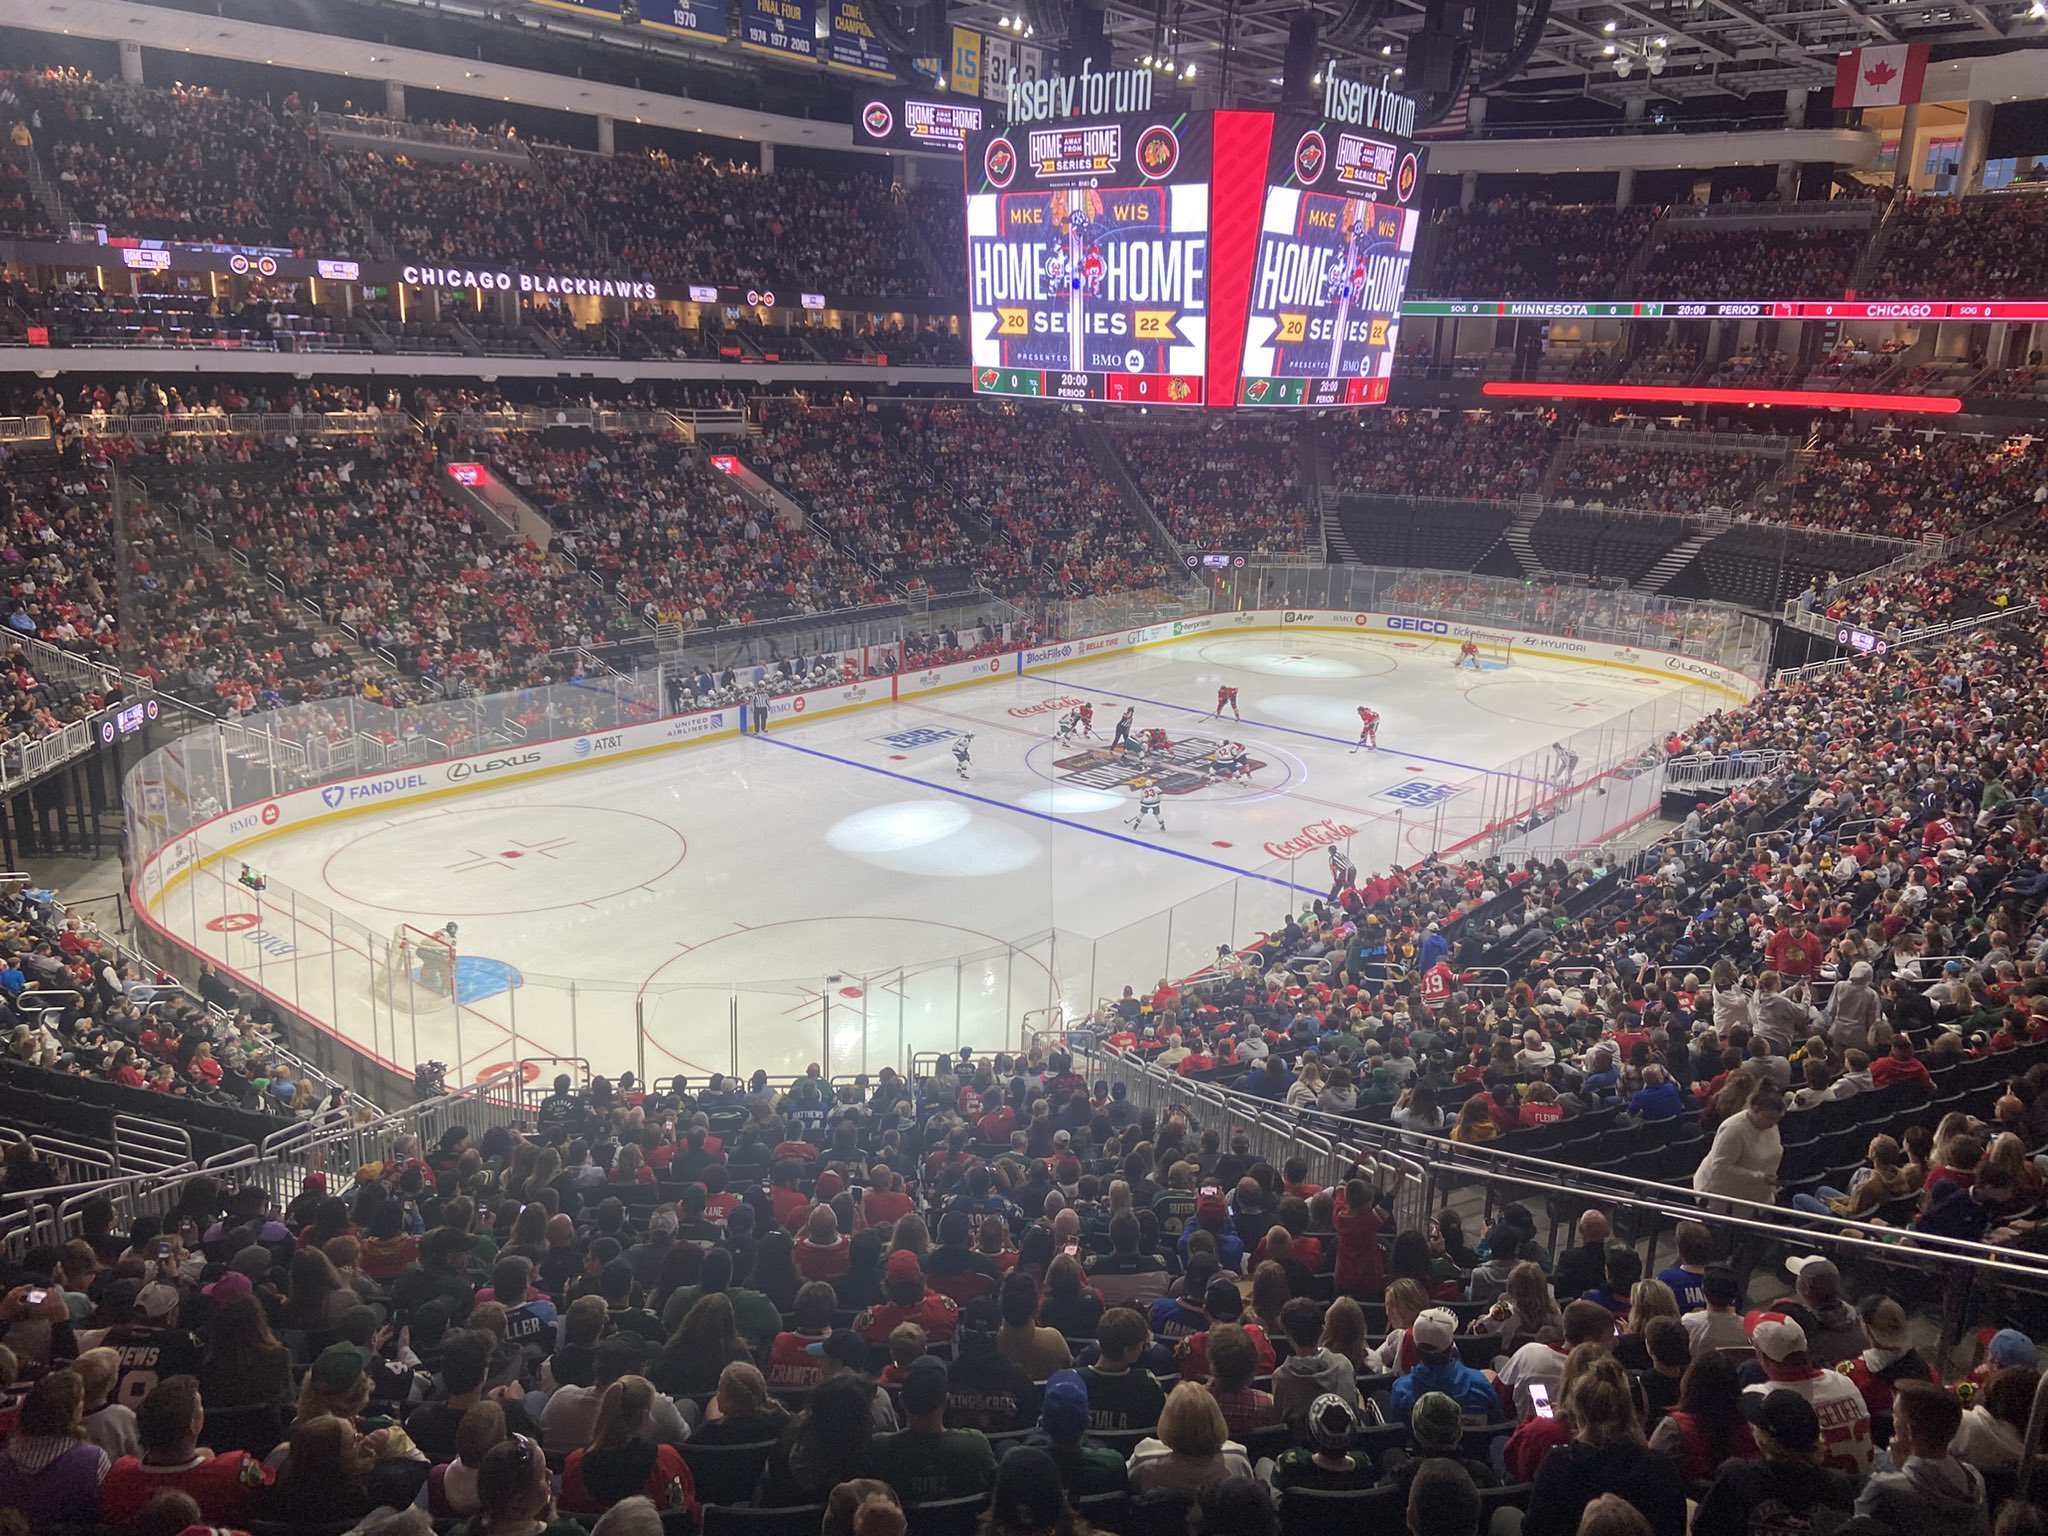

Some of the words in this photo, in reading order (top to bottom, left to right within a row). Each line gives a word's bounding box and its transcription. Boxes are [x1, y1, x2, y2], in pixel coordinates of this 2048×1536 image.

[781, 0, 801, 20] FOUR
[673, 9, 697, 28] 1970
[749, 28, 767, 43] 1974
[770, 32, 788, 47] 1977
[791, 37, 810, 53] 2003
[956, 47, 977, 79] 15
[991, 56, 1007, 85] 31
[908, 105, 935, 125] HOME
[952, 110, 979, 130] HOME
[929, 127, 960, 137] SERIES
[1032, 132, 1063, 162] HOME
[1084, 127, 1117, 157] HOME
[1064, 137, 1082, 146] AWAY
[1064, 145, 1082, 153] FROM
[1339, 138, 1364, 168] HOME
[1373, 146, 1395, 176] HOME
[1056, 161, 1091, 171] SERIES
[1354, 169, 1377, 182] SERIES
[1010, 208, 1043, 224] MKE
[1113, 204, 1149, 222] WIS
[1309, 209, 1336, 228] MKE
[1378, 220, 1395, 238] WIS
[974, 242, 1048, 306] HOME
[1107, 239, 1205, 309] HOME
[1258, 240, 1334, 310] HOME
[1361, 254, 1410, 319] HOME
[403, 266, 511, 290] CHICAGO
[519, 274, 656, 299] BLACKHAWKS
[1451, 305, 1466, 313] SOG
[1472, 304, 1479, 313] 0
[1511, 304, 1588, 315] MINNESOTA
[1610, 306, 1617, 315] 0
[1678, 305, 1706, 315] 20:00
[1718, 305, 1759, 315] PERIOD
[1764, 305, 1770, 315] 1
[1826, 305, 1833, 315] 0
[1866, 304, 1931, 317] CHICAGO
[1959, 306, 1977, 315] SOG
[1984, 306, 1991, 316] 0
[1008, 315, 1024, 328] 20
[1033, 311, 1127, 335] SEIES
[1140, 318, 1159, 331] 22
[1287, 321, 1302, 334] 20
[1308, 318, 1369, 341] SEIES
[1372, 326, 1382, 338] 22
[1017, 353, 1068, 362] PRESENTED
[1092, 355, 1121, 367] BMO
[1289, 361, 1328, 369] PRESENTED
[1011, 375, 1018, 387] 0
[1061, 374, 1088, 386] 20:00
[1320, 381, 1339, 392] 20:00
[1032, 386, 1037, 396] 1
[1058, 388, 1085, 397] PERIOD
[1090, 389, 1094, 398] 1
[1140, 382, 1146, 394] 0
[1279, 384, 1286, 397] 0
[1117, 392, 1122, 400] 1
[1386, 616, 1448, 635] GEICO
[1128, 630, 1147, 644] GTL
[1086, 641, 1105, 651] BELLE
[1105, 638, 1119, 648] TIRE
[1541, 640, 1586, 653] HYUNDAI
[1026, 649, 1062, 665] BlockFills
[972, 663, 989, 674] BMO
[1682, 663, 1721, 680] LEXUS
[769, 702, 791, 715] BMO
[675, 717, 708, 729] UNITED
[667, 723, 709, 738] AIRLINES
[887, 727, 933, 741] BUD
[594, 735, 623, 752] AT&T
[891, 729, 958, 750] LIGHT
[1219, 748, 1229, 757] 12
[474, 752, 541, 774] LEXUS
[349, 774, 427, 800] FANDUEL
[1144, 789, 1156, 798] 33
[1386, 782, 1431, 799] BUD
[1403, 784, 1463, 808] LIGHT
[230, 814, 258, 834] BMO
[1424, 974, 1443, 994] 19
[792, 1110, 824, 1120] MATTHEWS
[703, 1206, 724, 1217] KANE
[1169, 1203, 1195, 1214] SUTER
[1815, 1398, 1864, 1427] SEIDER
[1087, 1410, 1128, 1430] FIALA
